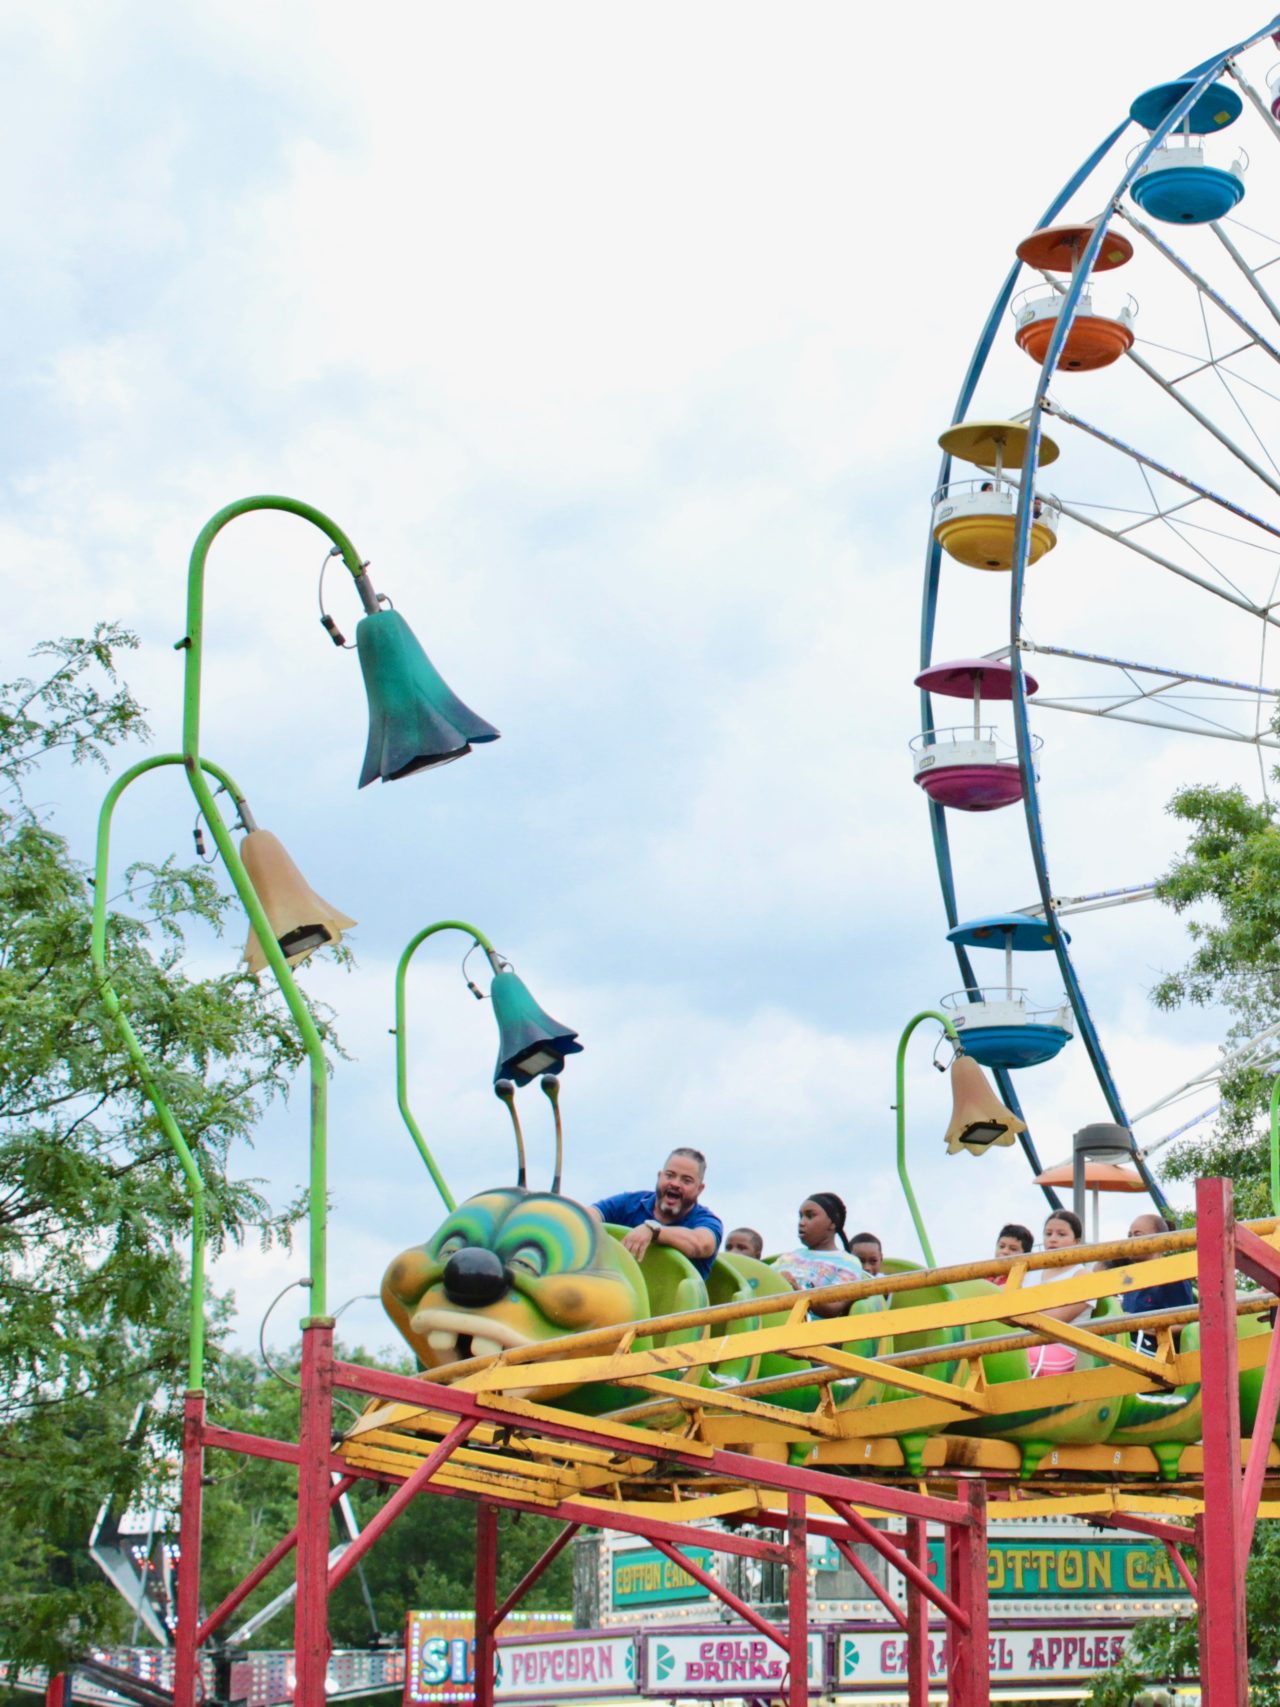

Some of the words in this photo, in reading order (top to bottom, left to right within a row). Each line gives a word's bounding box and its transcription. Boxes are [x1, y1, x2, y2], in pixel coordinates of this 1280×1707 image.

[616, 1562, 662, 1595] COTTON
[987, 1549, 1112, 1589] OTTON
[511, 1645, 614, 1685] POPCORN
[700, 1641, 768, 1661] COLD
[1028, 1636, 1125, 1669] APPLES
[685, 1660, 783, 1681] DRINKS
